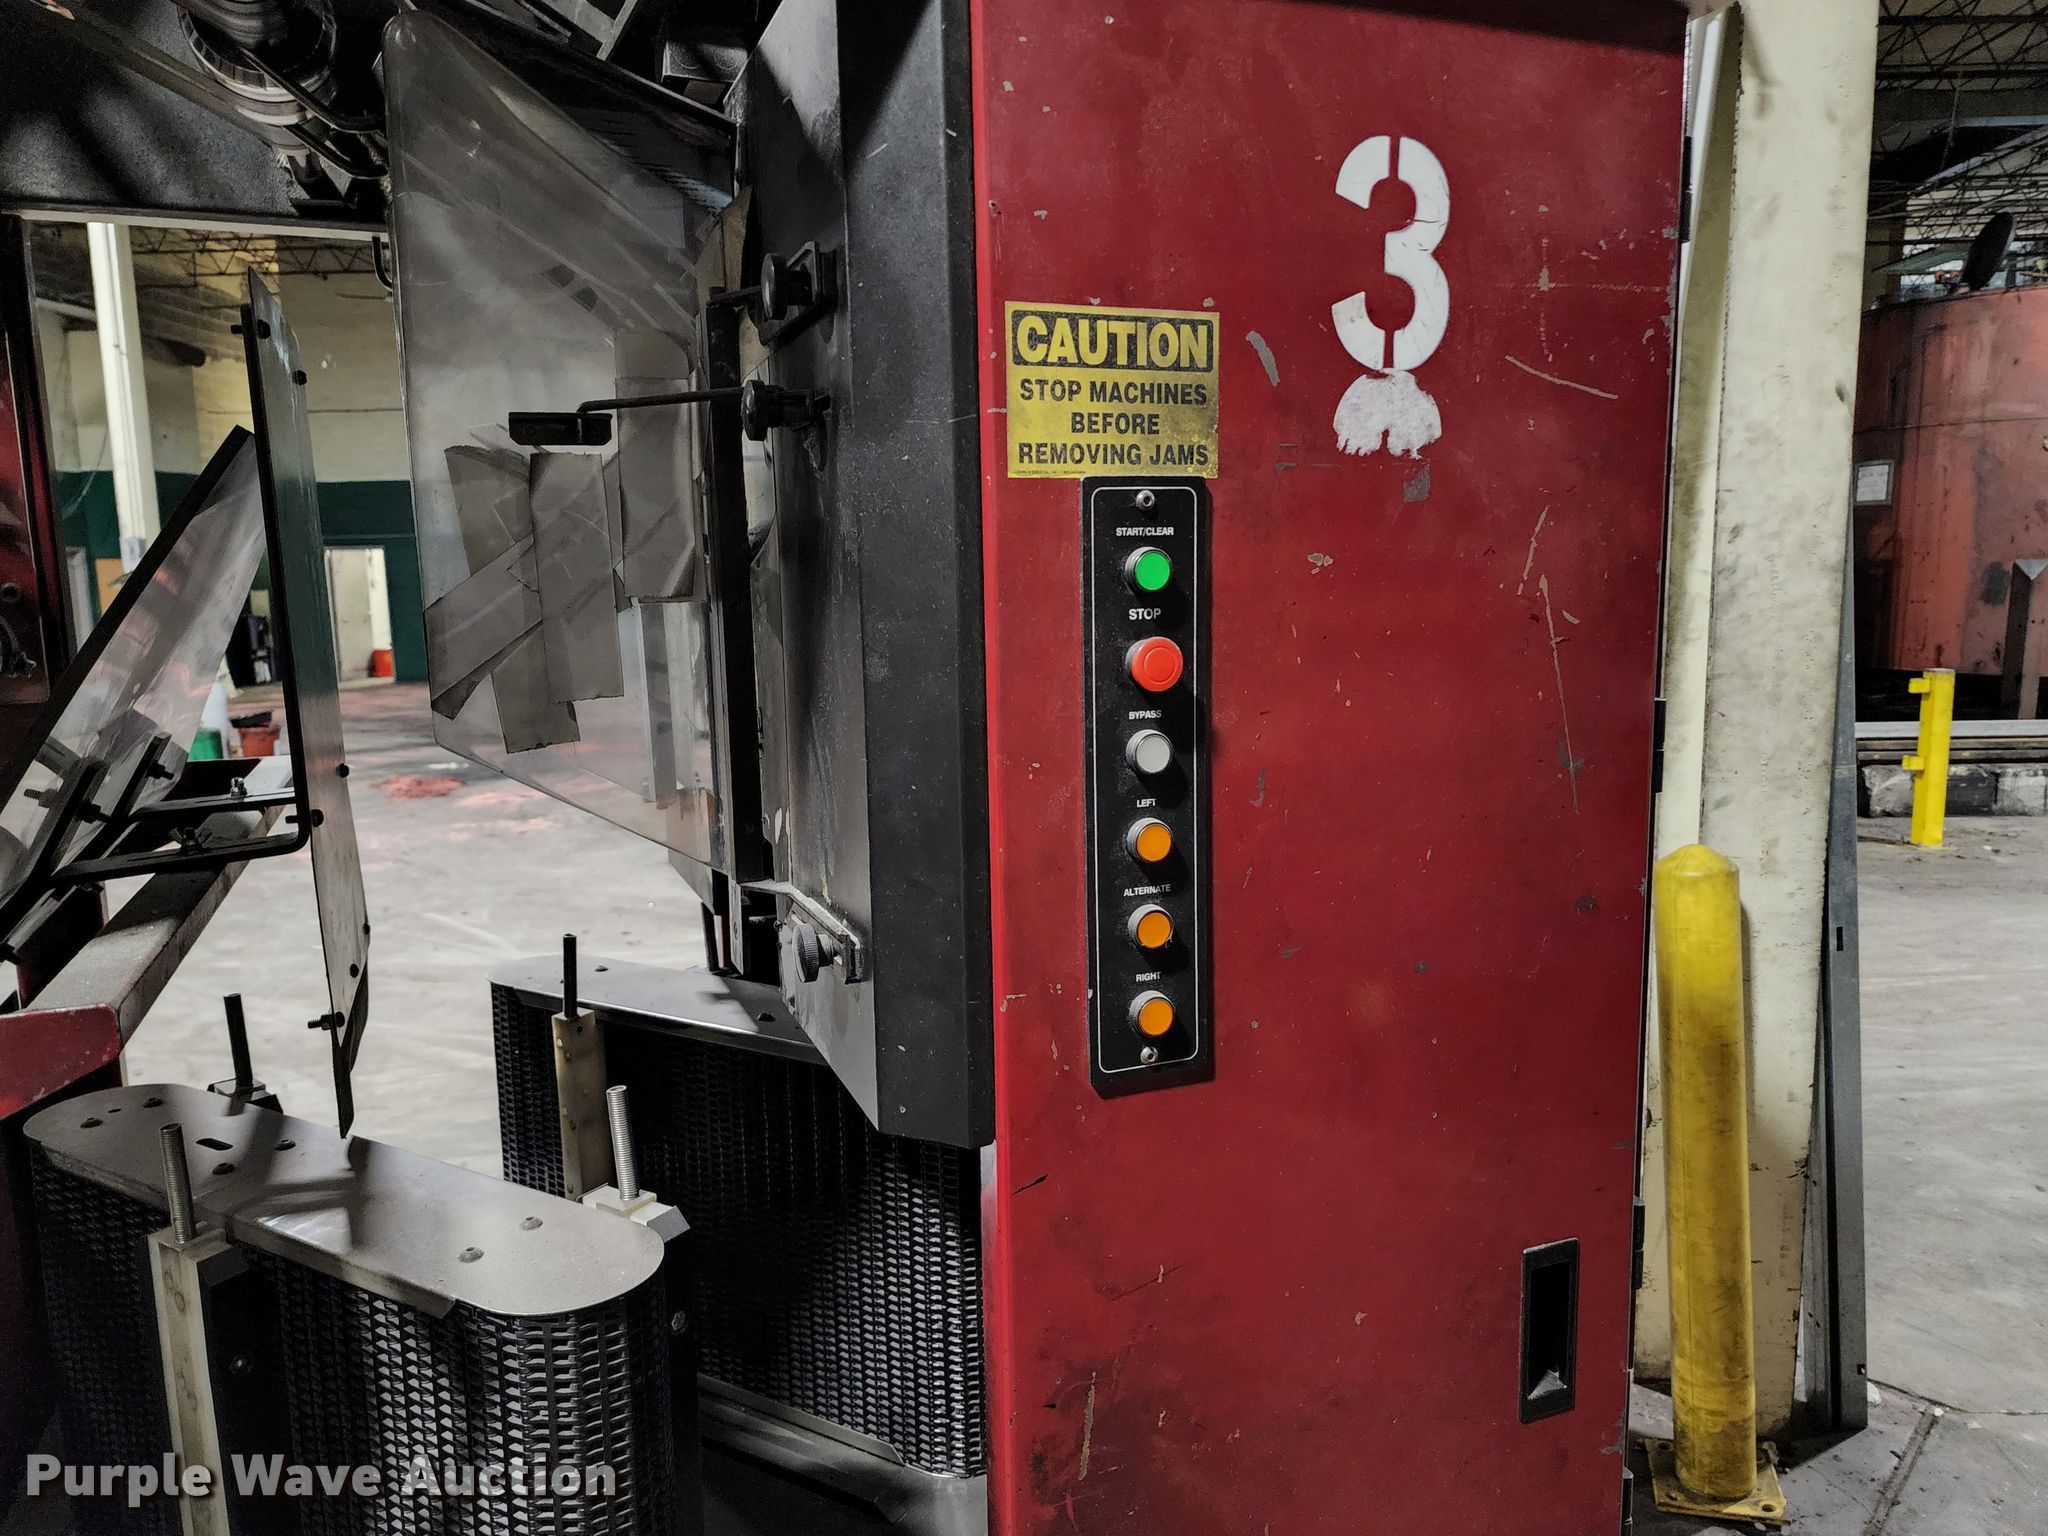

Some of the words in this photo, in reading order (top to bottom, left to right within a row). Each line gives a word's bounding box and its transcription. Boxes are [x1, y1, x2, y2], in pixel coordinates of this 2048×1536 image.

[1331, 134, 1451, 371] 3
[1016, 315, 1208, 368] CAUTION
[1020, 378, 1082, 402] STOP
[1089, 381, 1207, 406] MACHINES
[1071, 412, 1160, 435] BEFORE
[1018, 442, 1142, 465] REMOVING
[1149, 445, 1209, 466] JAMS
[1115, 527, 1175, 537] START/CLEAR
[1128, 608, 1162, 620] STOP
[1128, 710, 1162, 720] BYPASS
[1136, 799, 1156, 808] LEFT
[1123, 884, 1171, 897] ALTERNATE
[1135, 971, 1161, 982] RIGHT
